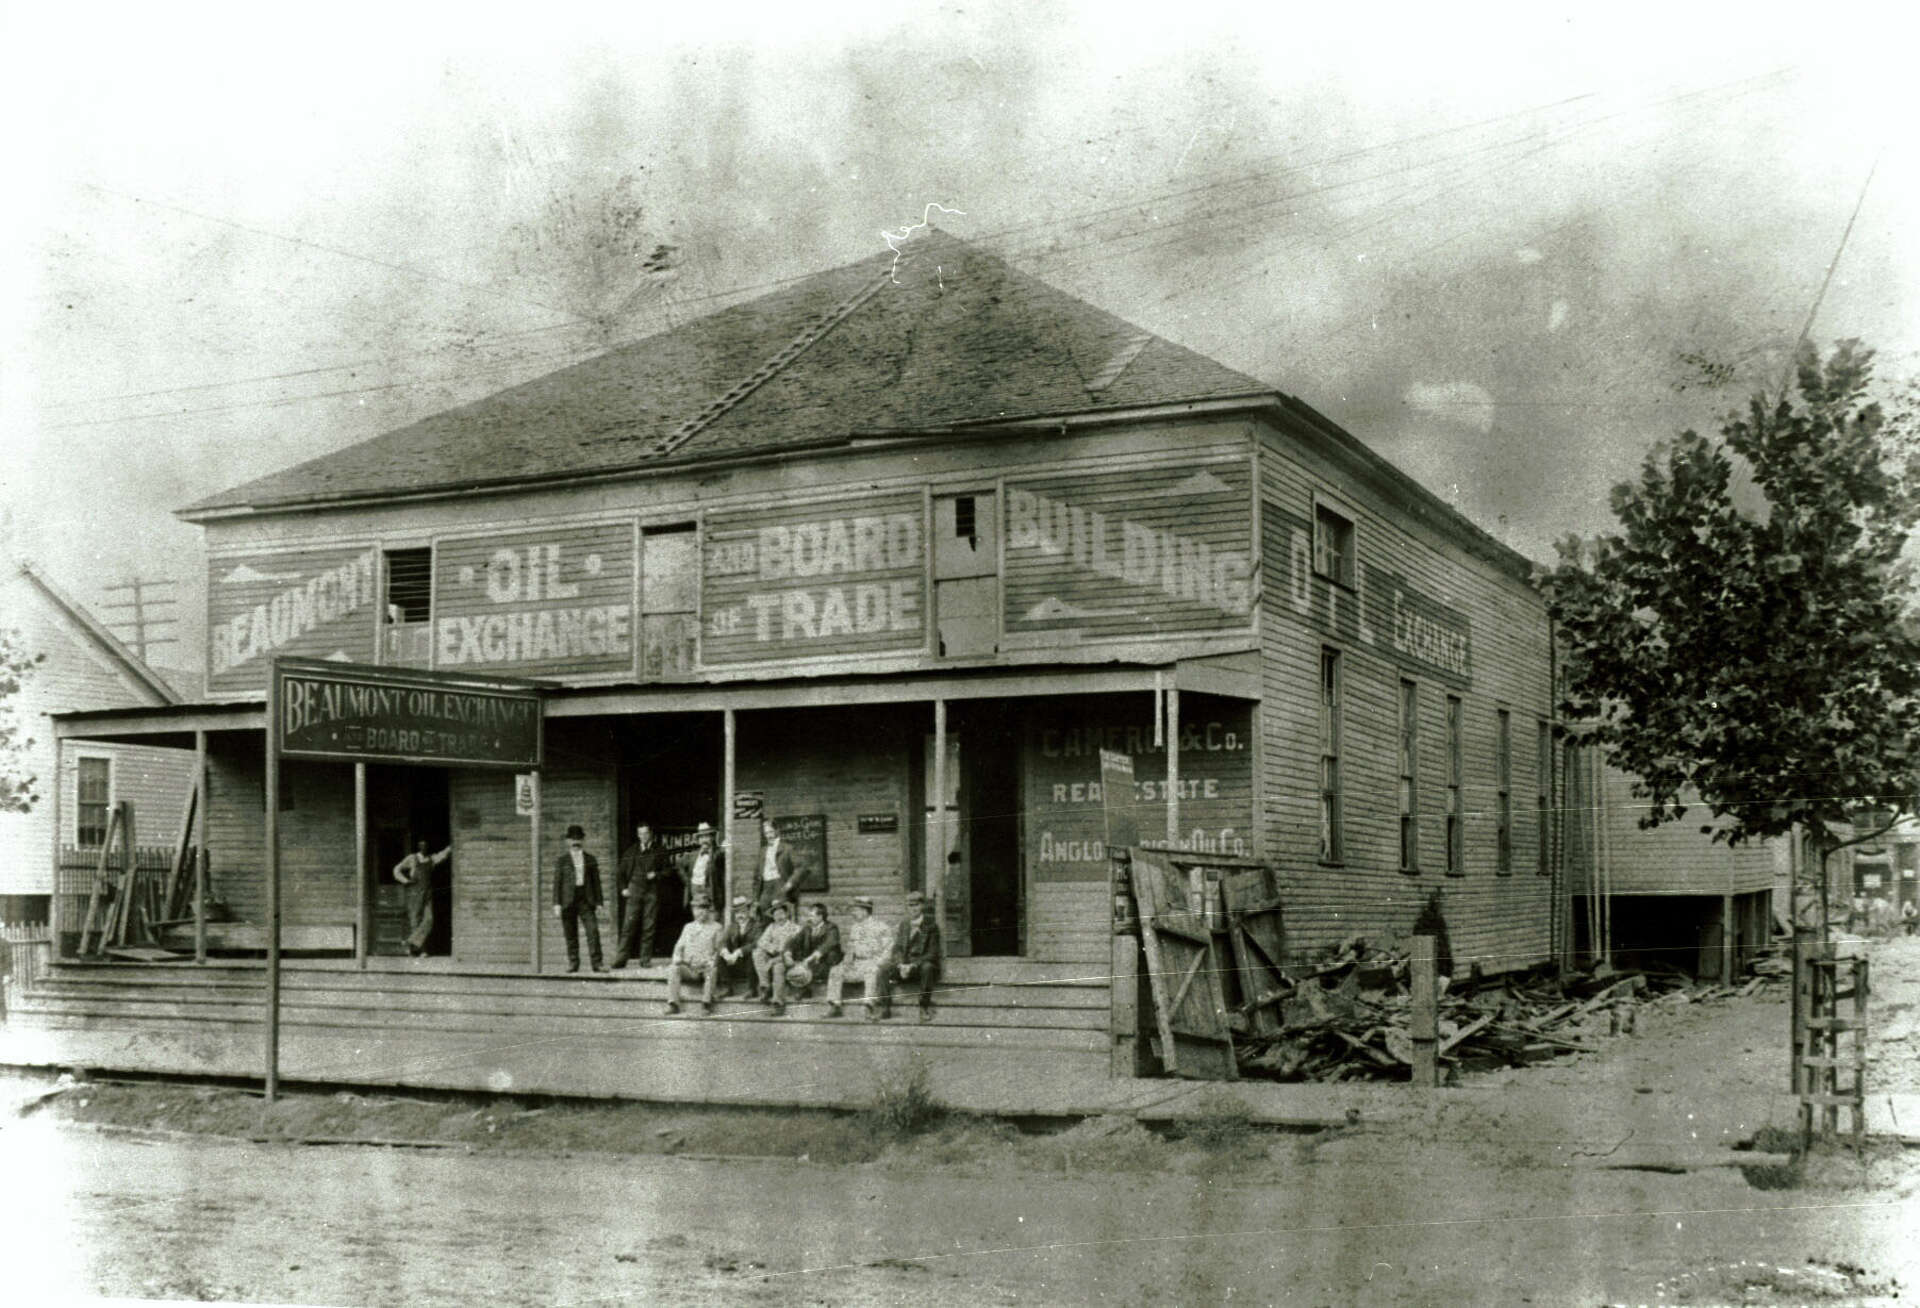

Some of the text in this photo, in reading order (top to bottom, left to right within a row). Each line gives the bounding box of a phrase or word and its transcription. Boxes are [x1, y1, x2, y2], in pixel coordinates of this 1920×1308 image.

[486, 545, 579, 603] OIL
[710, 513, 918, 579] AND BOARD
[1009, 488, 1251, 615] BUILDING
[211, 550, 374, 676] BEAUMONT
[438, 604, 630, 666] EXCHANGE
[711, 580, 920, 641] OF TRADE
[286, 680, 404, 735] BEAUMONT
[409, 690, 441, 718] OIL
[366, 728, 420, 751] BOARD
[1042, 725, 1168, 758] CAMERO
[1052, 778, 1219, 802] REA STATE
